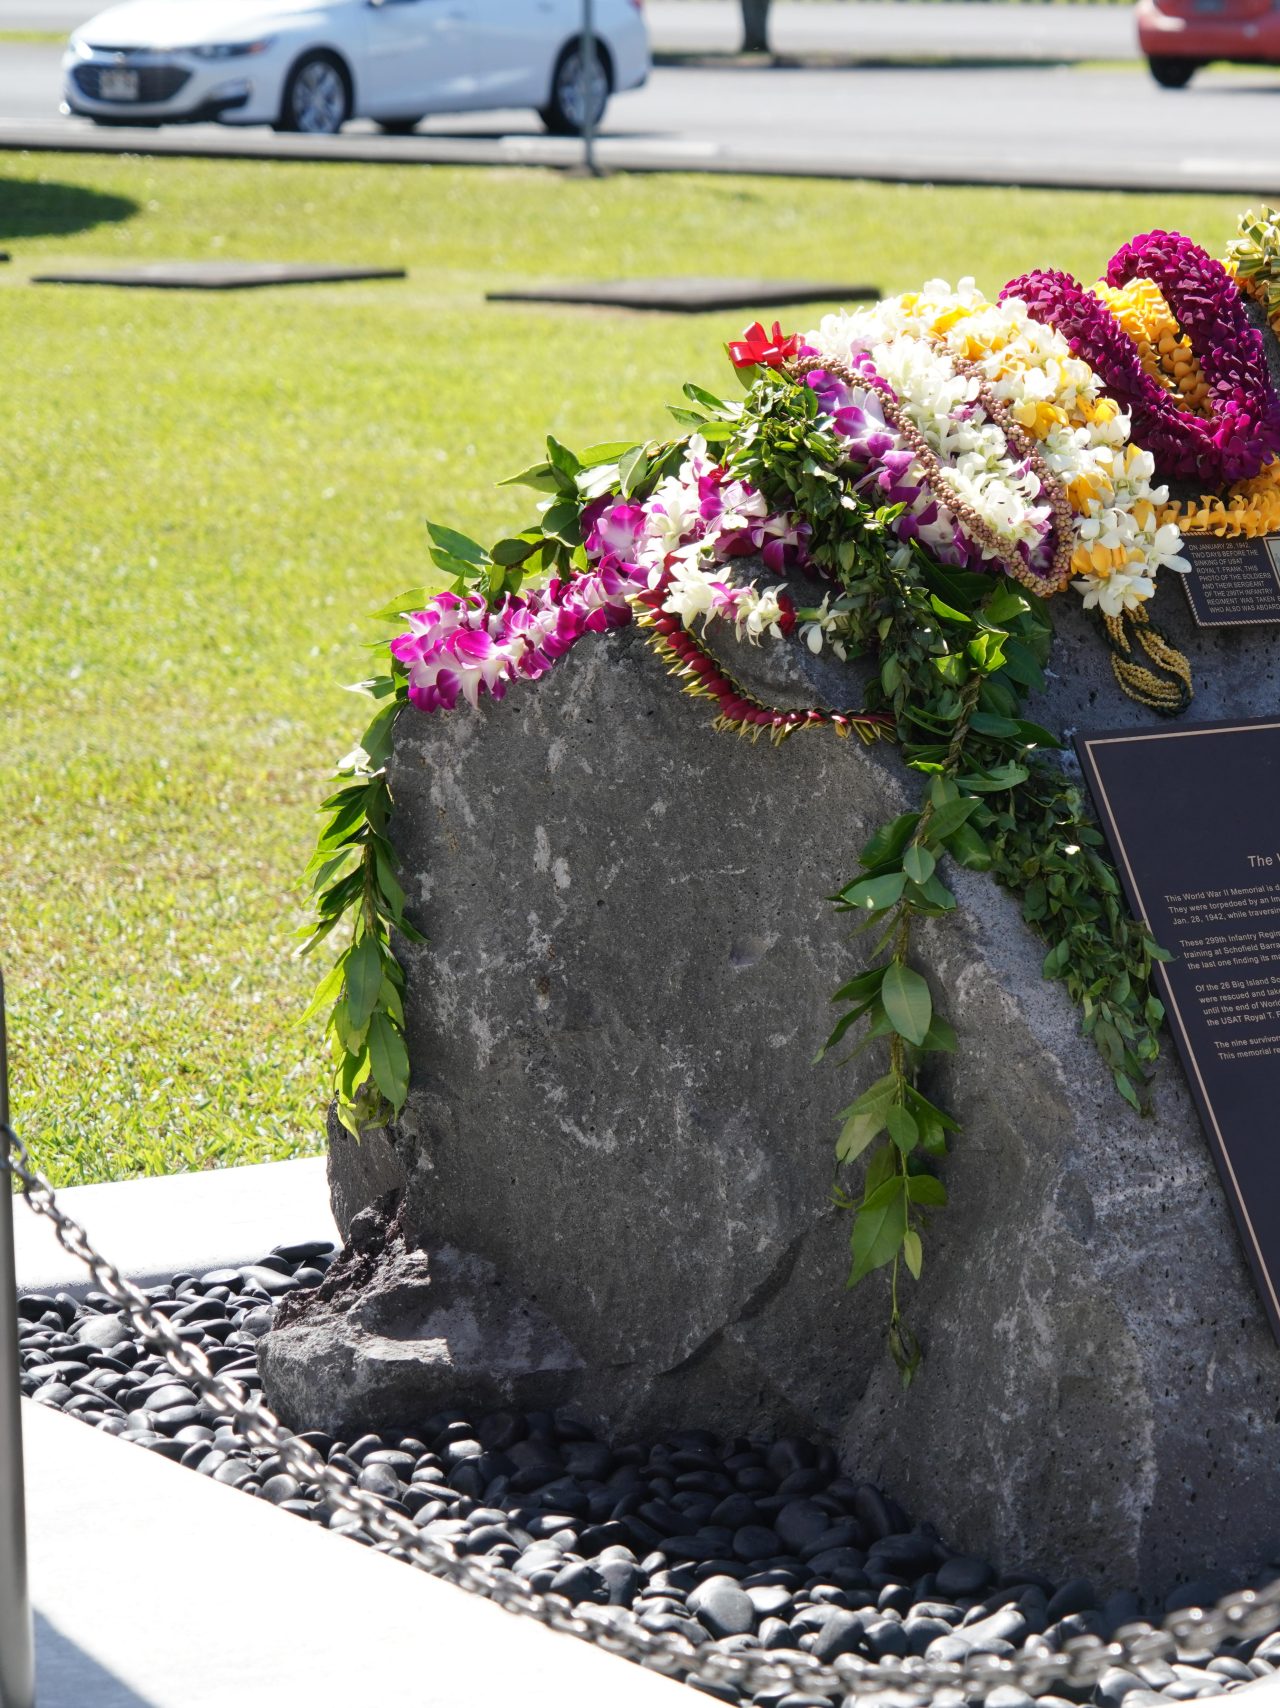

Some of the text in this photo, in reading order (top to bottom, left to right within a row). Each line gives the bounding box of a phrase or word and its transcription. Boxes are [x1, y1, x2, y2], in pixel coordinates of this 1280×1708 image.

[1247, 856, 1272, 867] The
[1168, 906, 1188, 914] They
[1209, 899, 1248, 909] torpedoed
[1248, 898, 1258, 906] by
[1218, 1052, 1235, 1060] This
[1236, 1047, 1272, 1058] memorial
